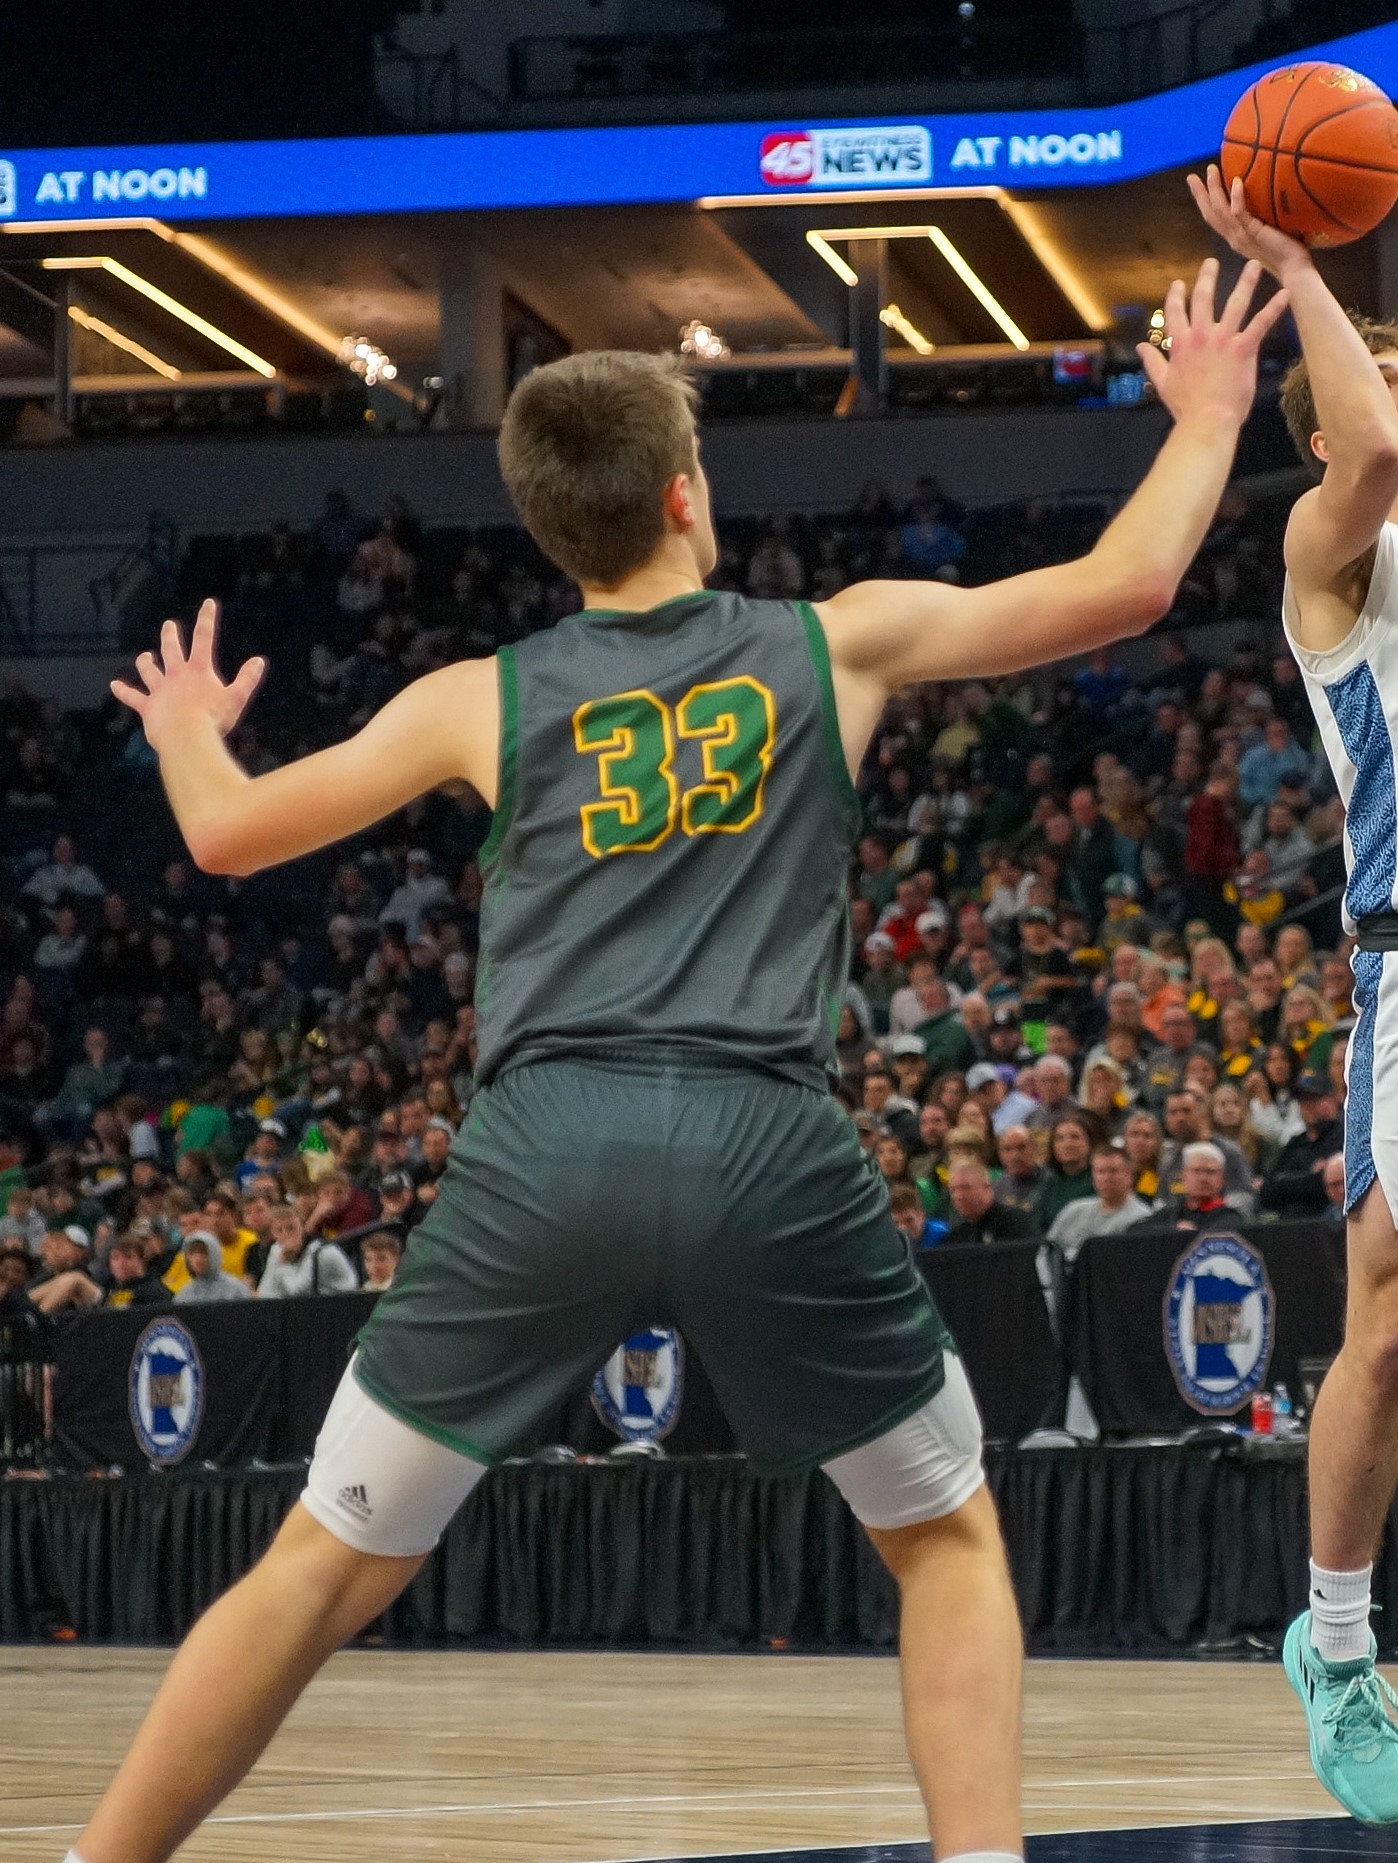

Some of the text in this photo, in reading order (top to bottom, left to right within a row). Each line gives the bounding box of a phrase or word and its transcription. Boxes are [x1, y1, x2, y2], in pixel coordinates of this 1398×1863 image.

[760, 141, 813, 179] 45
[823, 148, 923, 174] NEWS
[951, 130, 1123, 169] AT NOON
[35, 171, 85, 204] AT
[92, 166, 207, 202] NOON
[572, 674, 776, 859] 33
